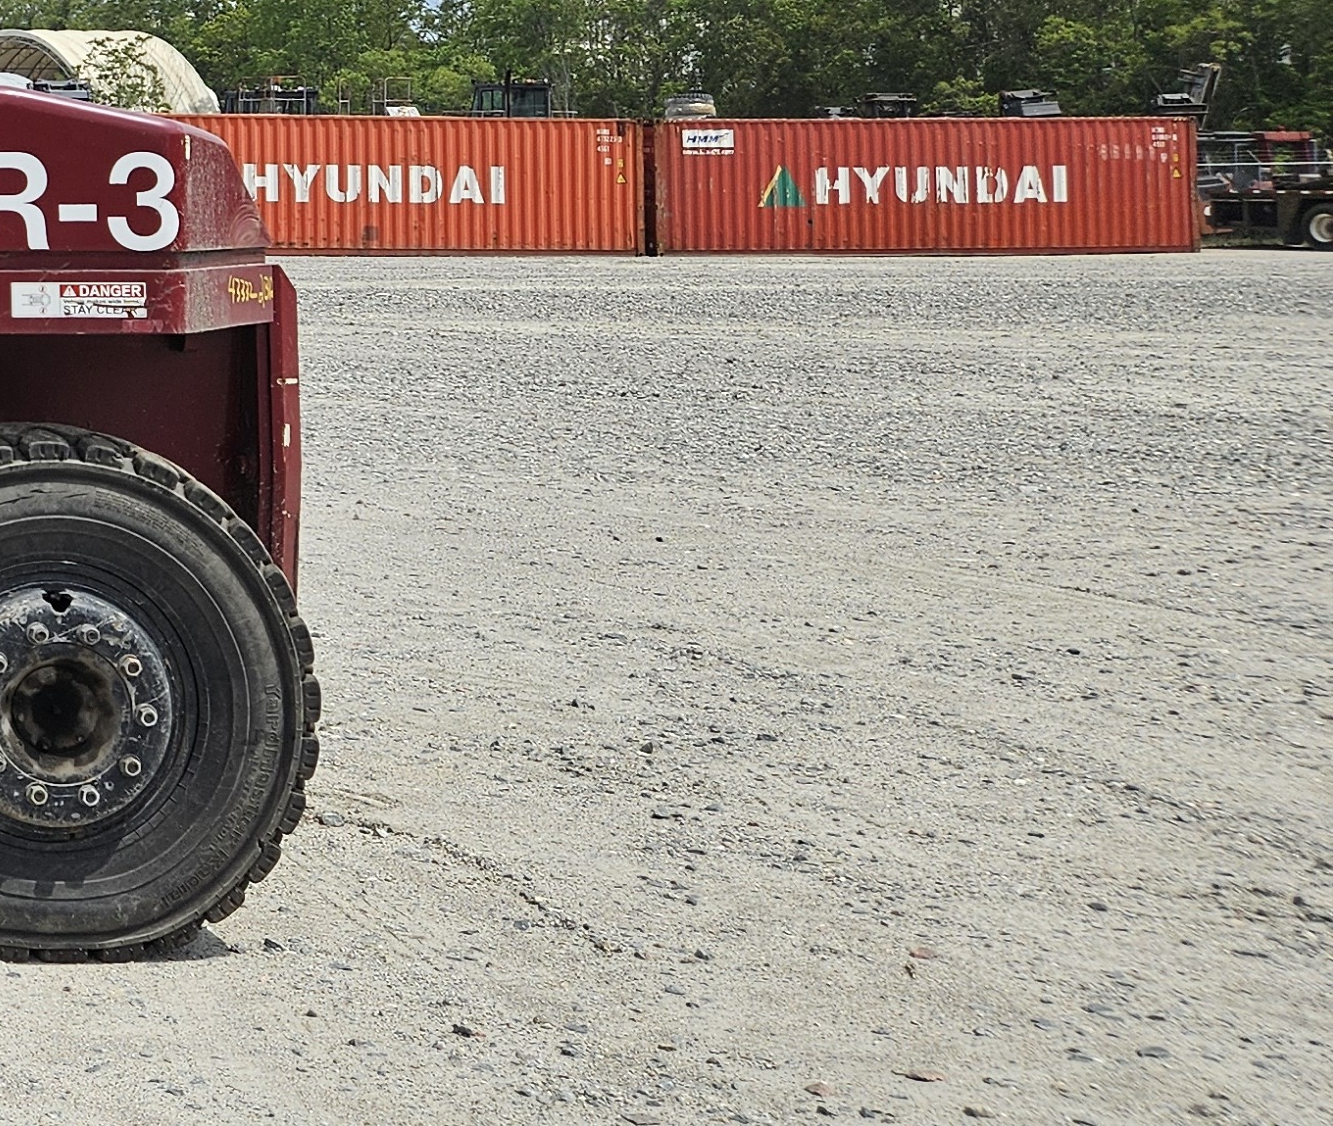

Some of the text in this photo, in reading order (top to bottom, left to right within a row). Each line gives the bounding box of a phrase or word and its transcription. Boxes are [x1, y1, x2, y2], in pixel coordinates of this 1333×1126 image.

[242, 163, 505, 204] HYUNDAI
[814, 164, 1068, 205] HYUNDAI
[79, 284, 143, 297] DANGER
[63, 305, 93, 315] STAY
